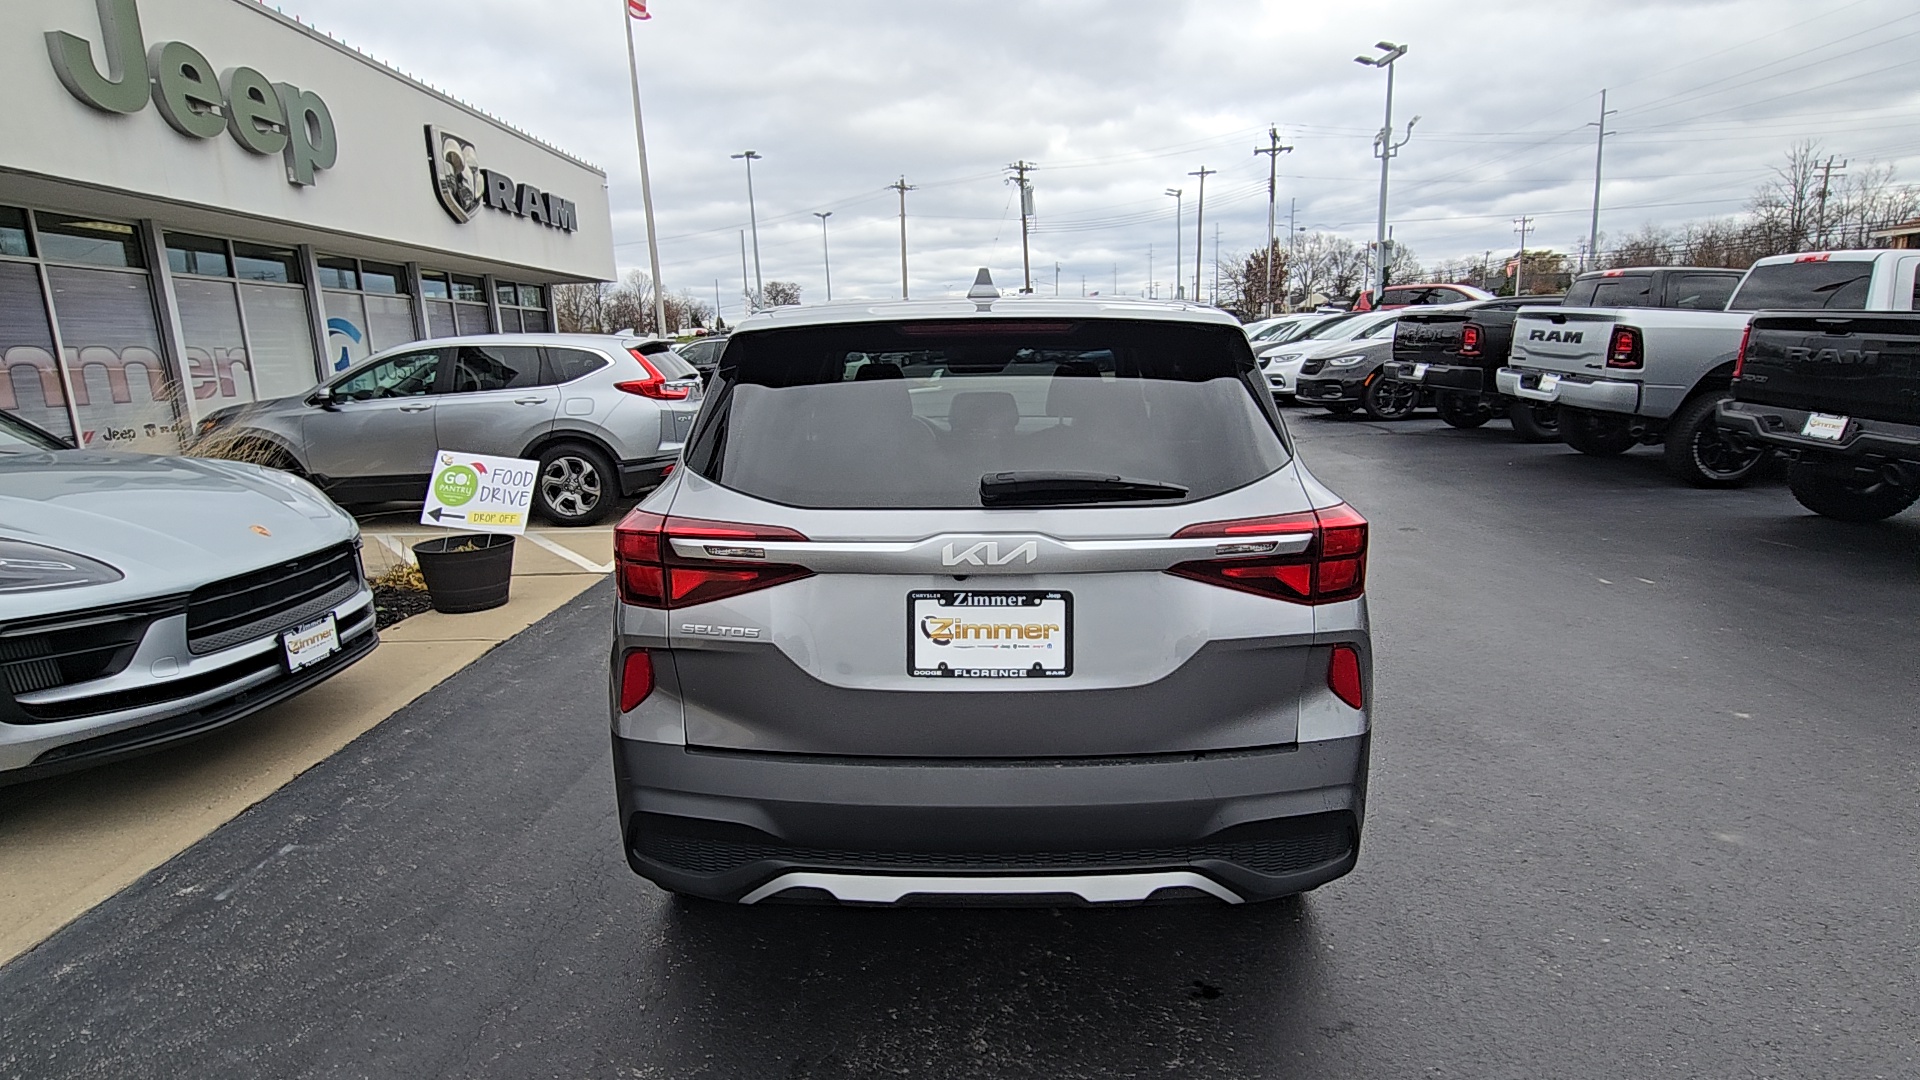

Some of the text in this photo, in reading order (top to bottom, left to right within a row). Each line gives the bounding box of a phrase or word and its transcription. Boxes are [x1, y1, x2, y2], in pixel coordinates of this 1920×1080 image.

[44, 0, 338, 187] Jeep
[480, 169, 578, 232] RAM
[1529, 329, 1584, 344] RAM
[1785, 346, 1880, 364] RAM
[103, 427, 137, 442] Jeep
[491, 468, 534, 488] FOOD
[439, 484, 473, 497] PANTRY
[479, 485, 530, 507] DRIVE
[473, 513, 517, 524] DROP OFF
[942, 541, 1037, 566] KIA
[953, 592, 1027, 606] Zimmer
[680, 623, 761, 638] SELTOS
[929, 617, 1060, 640] Zimmer
[290, 629, 334, 653] Zimmer
[954, 669, 1028, 677] FLORENCE
